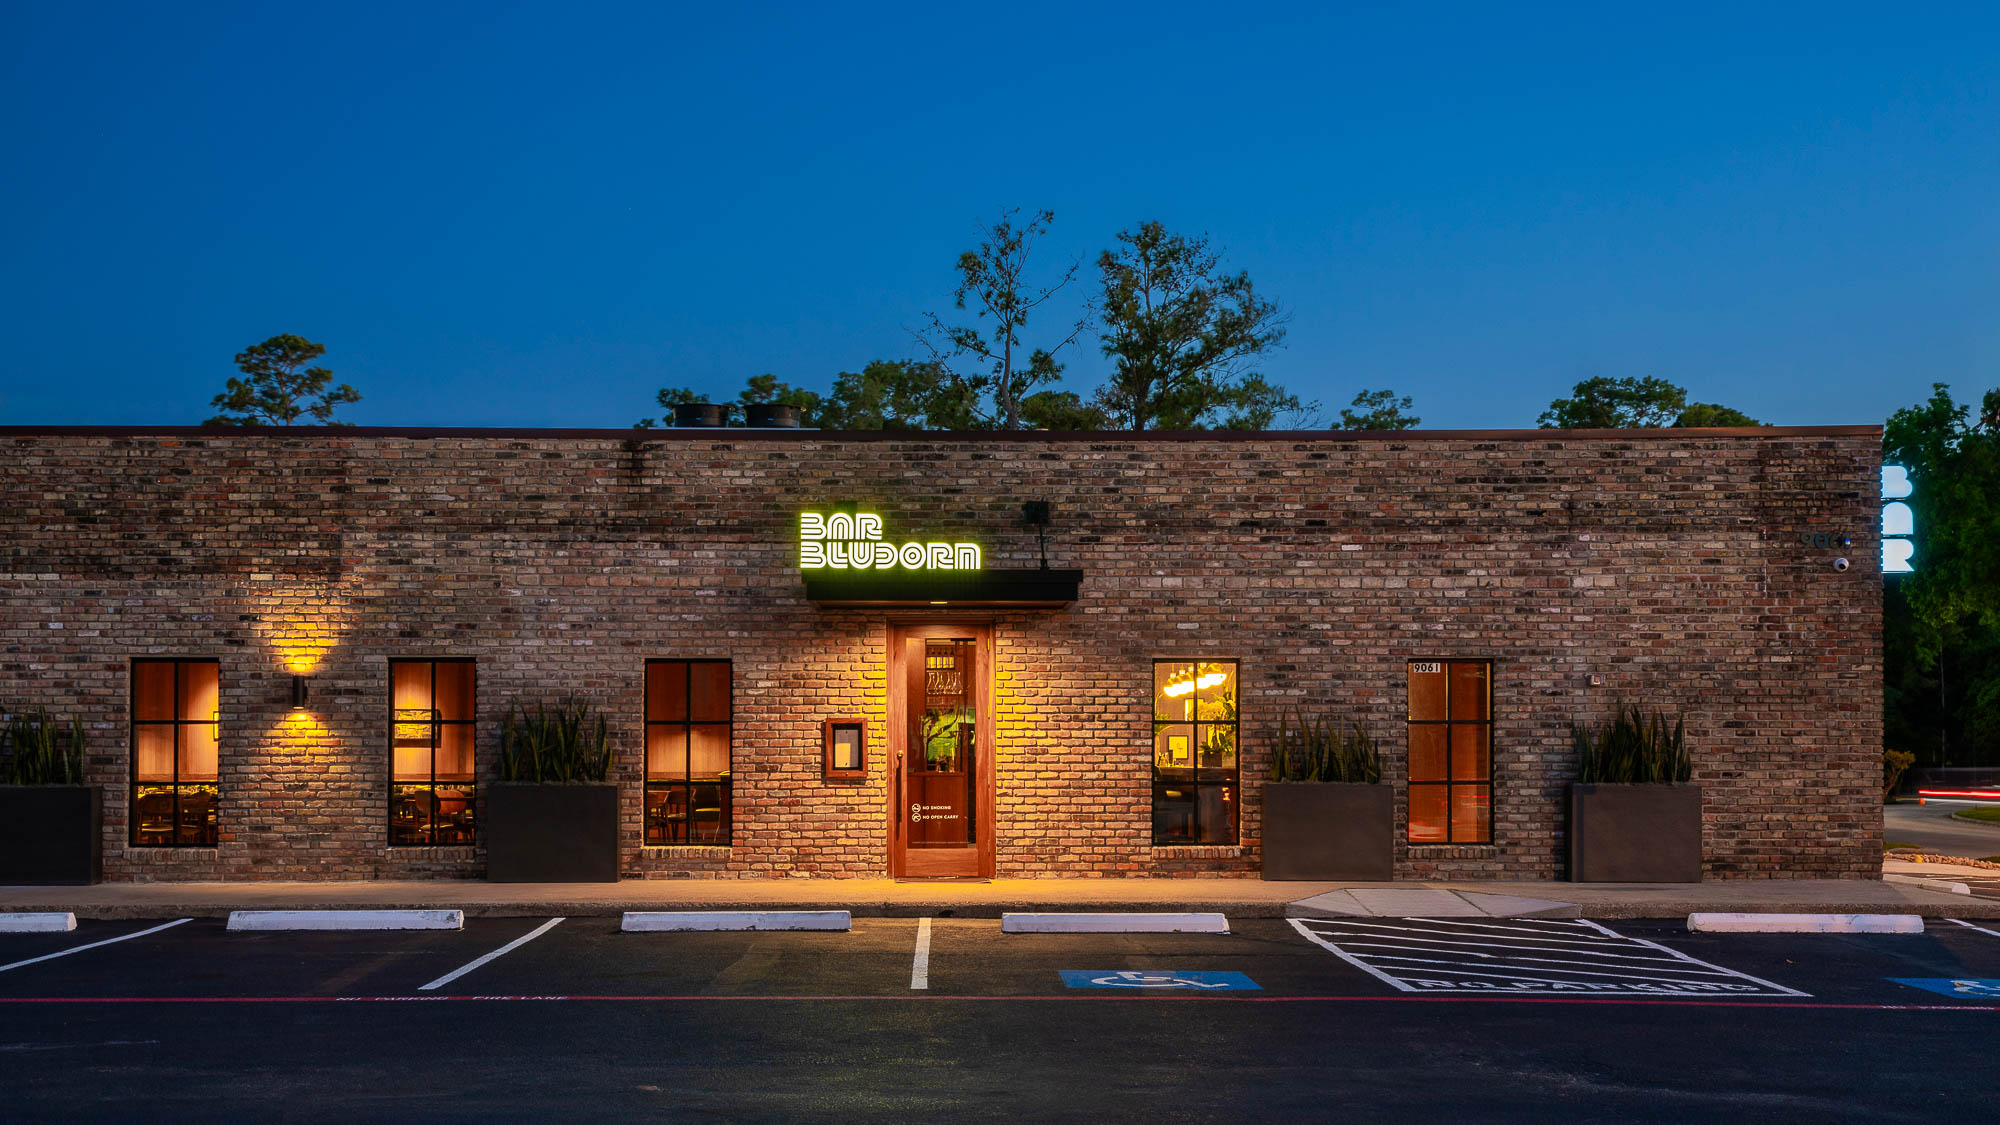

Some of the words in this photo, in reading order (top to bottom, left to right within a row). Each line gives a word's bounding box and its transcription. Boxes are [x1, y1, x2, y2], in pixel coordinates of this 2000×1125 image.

[800, 512, 883, 541] BAR
[1880, 465, 1915, 573] BAR
[800, 541, 981, 570] BLUDORN
[1414, 663, 1439, 673] 9061
[1511, 982, 1761, 991] PARKING
